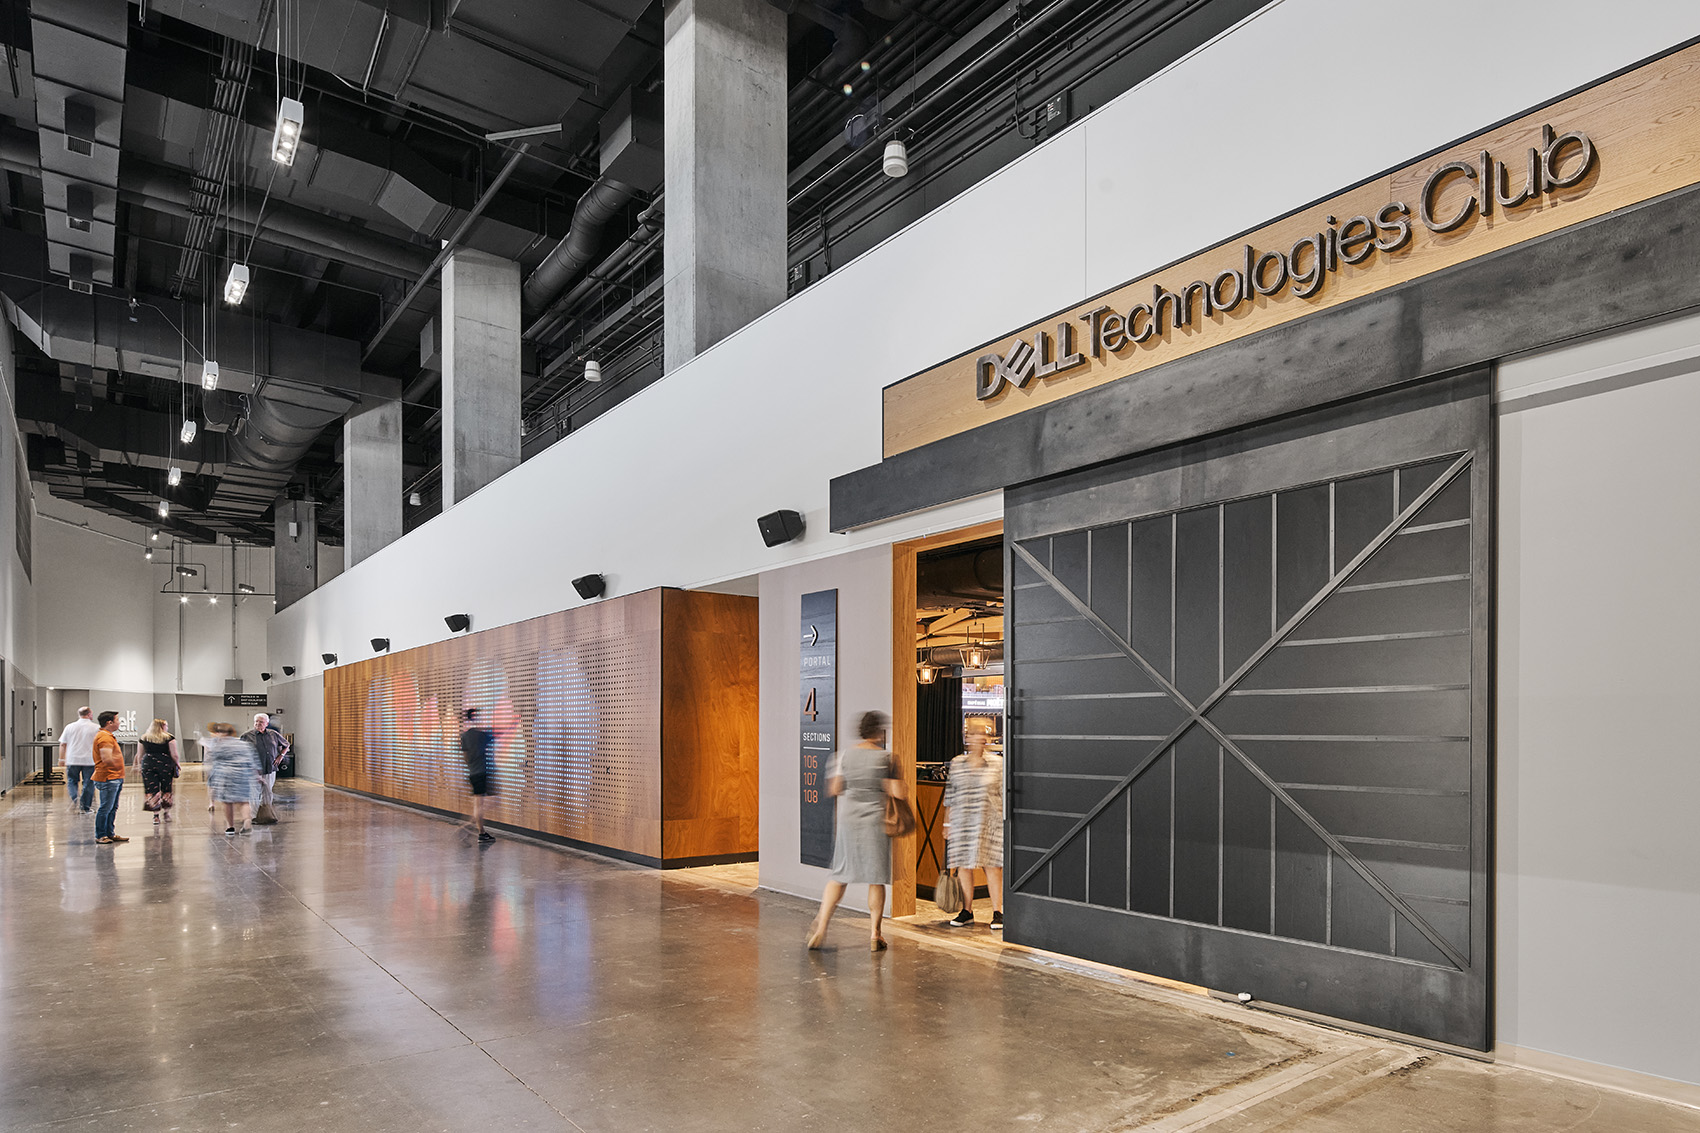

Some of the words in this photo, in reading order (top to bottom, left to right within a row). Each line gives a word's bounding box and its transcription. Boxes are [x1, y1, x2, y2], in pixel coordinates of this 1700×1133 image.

[976, 322, 1083, 400] DELL
[1079, 199, 1412, 358] Technologies
[1419, 122, 1594, 234] Club
[804, 655, 831, 667] PORTAL
[803, 687, 818, 722] 4
[802, 732, 831, 743] SECTIONS
[803, 755, 818, 769] 106
[803, 772, 817, 786] 107
[803, 789, 818, 803] 108
